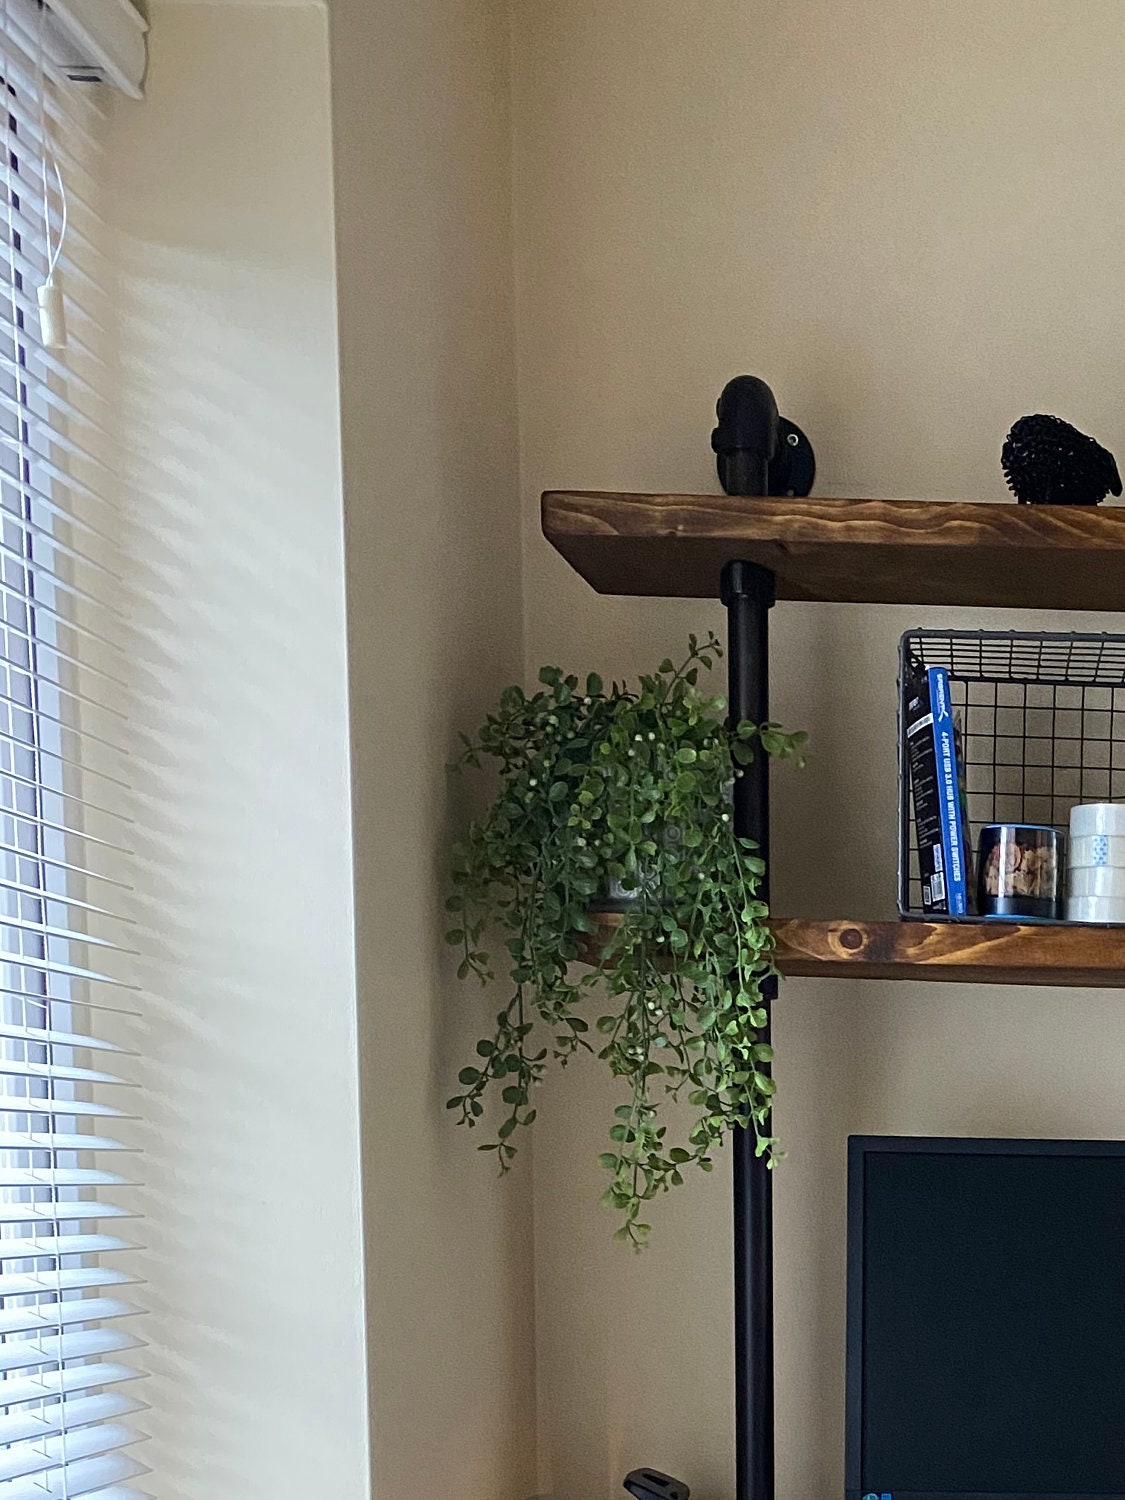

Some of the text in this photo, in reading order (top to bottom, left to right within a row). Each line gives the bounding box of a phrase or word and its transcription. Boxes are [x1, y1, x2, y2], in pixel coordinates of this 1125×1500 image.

[941, 731, 951, 757] 4-PORT
[943, 757, 952, 773] USB
[944, 773, 953, 785] 3.0
[946, 785, 955, 801] HUB
[947, 801, 956, 820] WITH
[949, 820, 959, 846] POWER
[951, 846, 961, 882] SWITCHES
